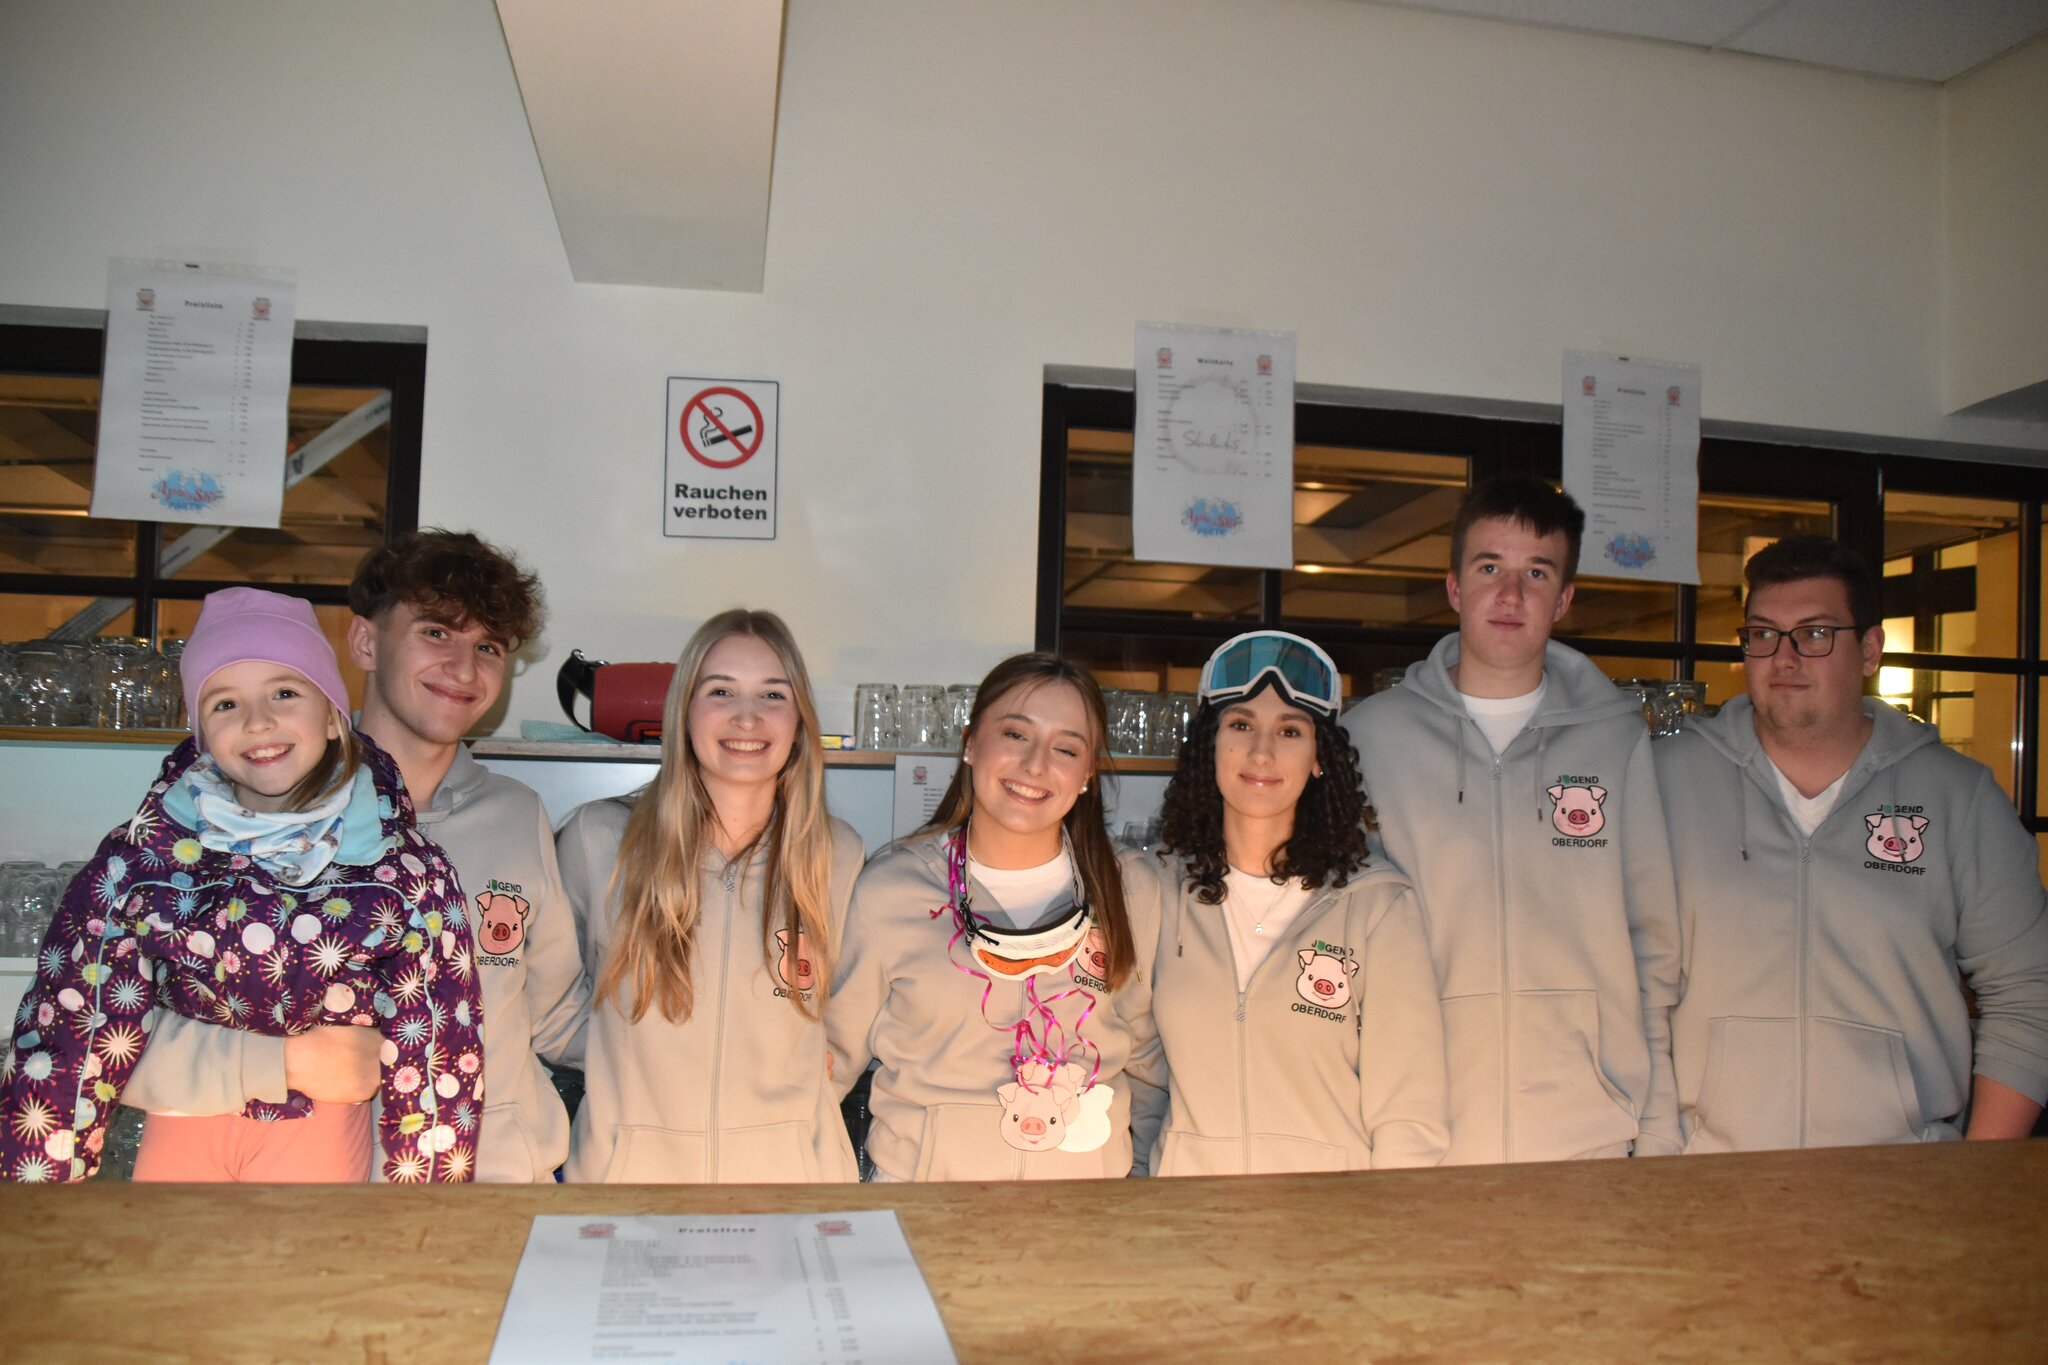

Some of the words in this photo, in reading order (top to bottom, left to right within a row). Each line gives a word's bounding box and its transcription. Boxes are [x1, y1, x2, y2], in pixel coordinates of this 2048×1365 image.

[674, 483, 767, 501] Rauchen
[673, 504, 768, 521] verboten
[1552, 837, 1608, 848] OBERDORF
[1864, 860, 1926, 876] OBERDORF
[1074, 975, 1112, 995] OBERDO
[1291, 1003, 1347, 1024] OBERDORF
